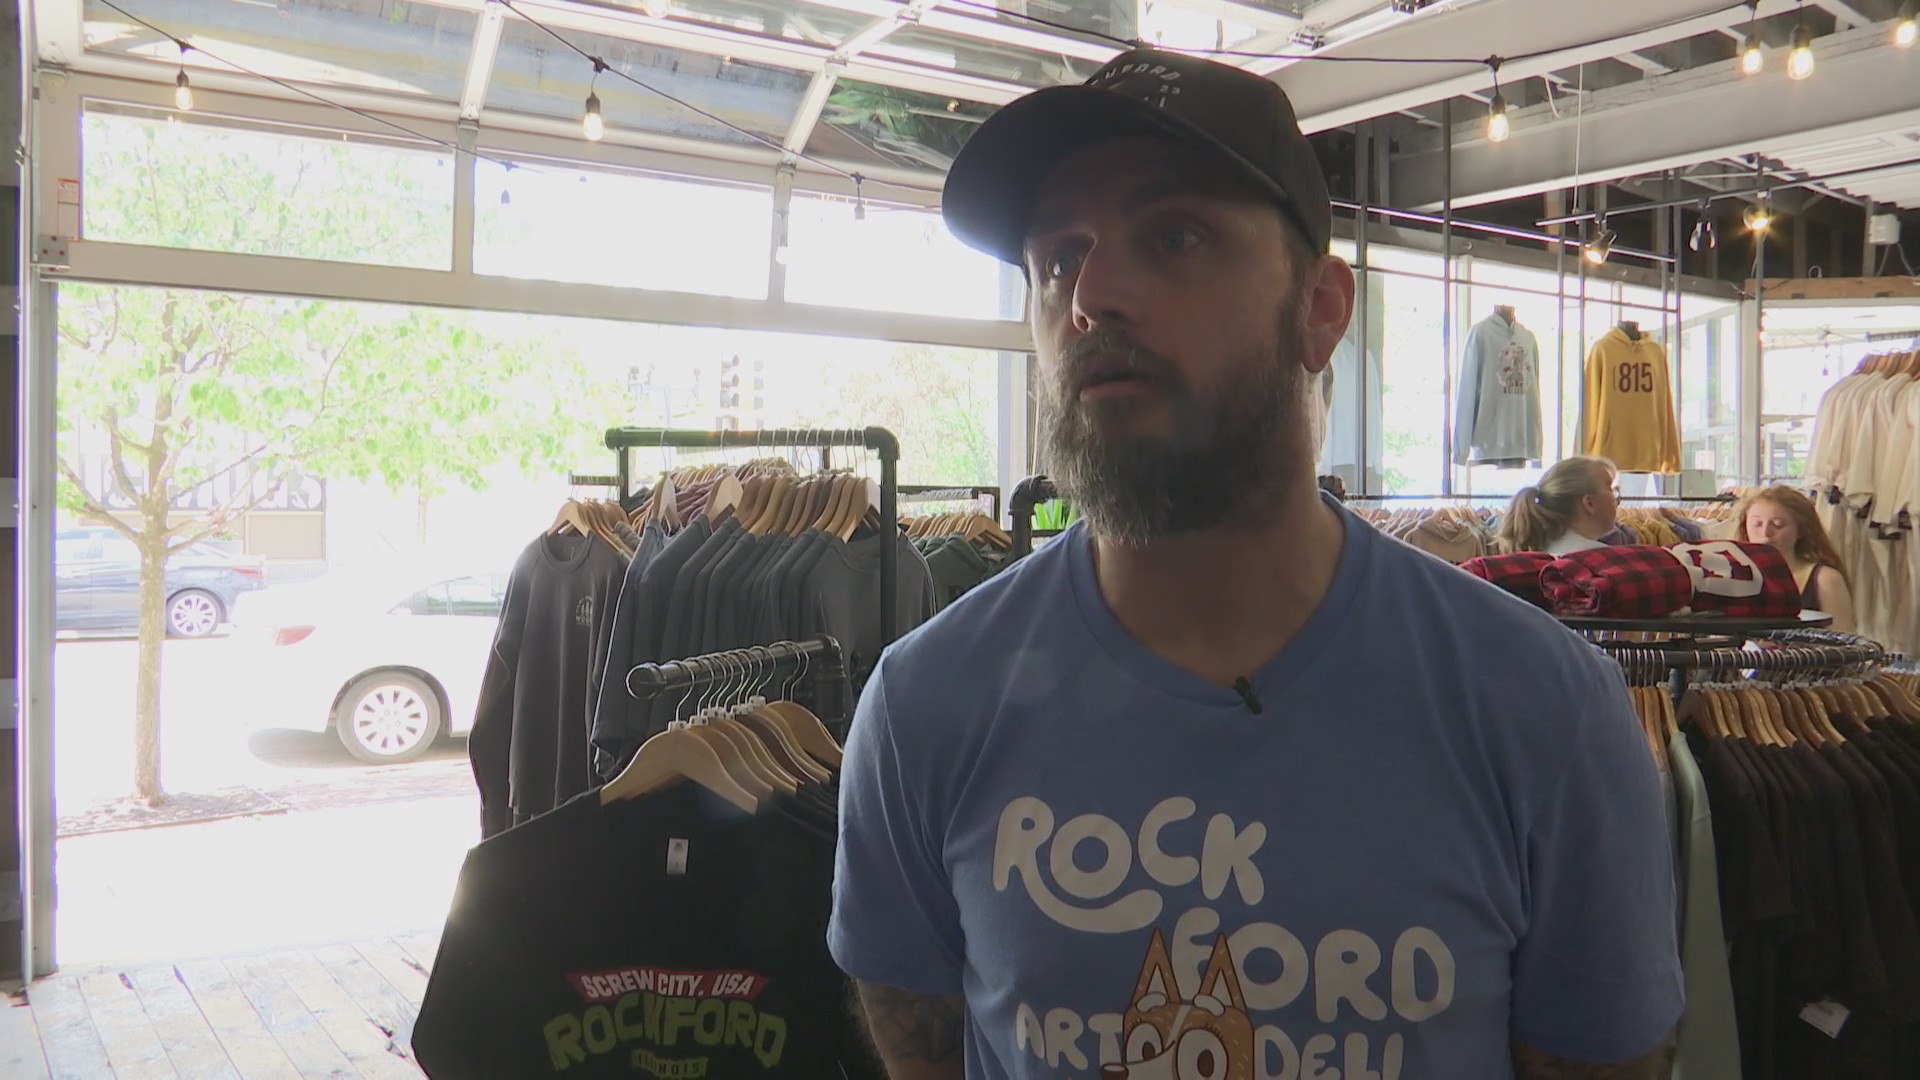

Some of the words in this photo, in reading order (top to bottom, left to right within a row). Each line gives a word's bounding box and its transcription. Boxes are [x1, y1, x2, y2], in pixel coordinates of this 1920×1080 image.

[993, 796, 1267, 933] ROCK
[580, 969, 655, 999] SCREW
[711, 973, 755, 996] USA
[1171, 907, 1456, 1023] FORD
[543, 992, 788, 1071] ROCKFORD
[1015, 1002, 1124, 1071] ART
[1255, 1024, 1404, 1080] DELI
